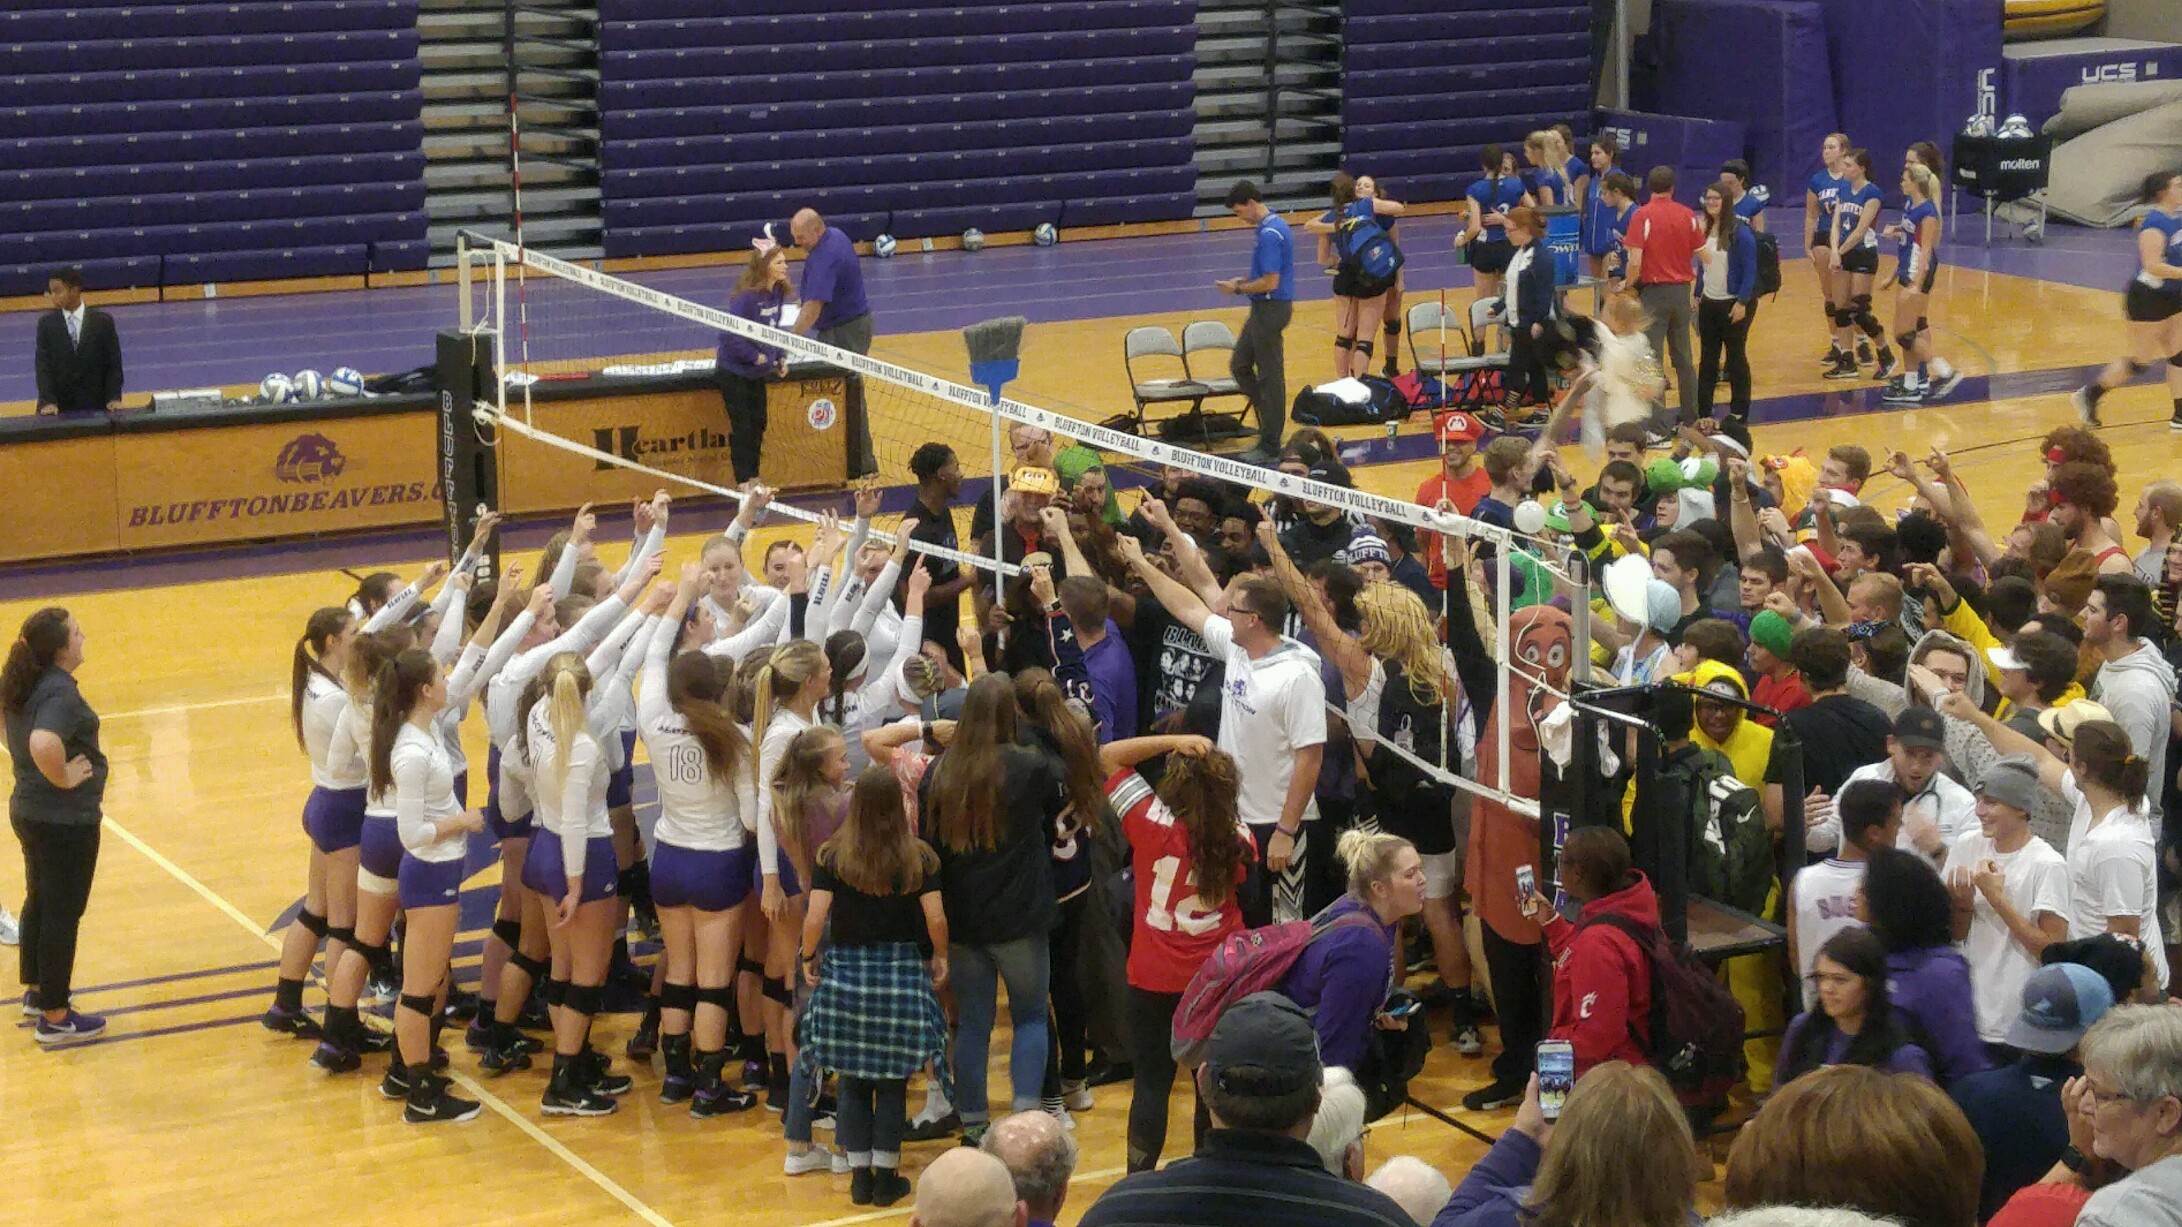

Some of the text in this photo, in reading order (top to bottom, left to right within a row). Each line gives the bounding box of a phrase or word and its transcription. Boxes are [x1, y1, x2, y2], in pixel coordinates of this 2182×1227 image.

[2081, 61, 2138, 84] UCS
[2000, 158, 2041, 171] molten
[851, 355, 924, 388] BLUFFTON VOLLEYBALL
[949, 385, 982, 405] BLUFFTON
[1053, 416, 1140, 453] BLUFFTON VOLLEYBALL
[1171, 449, 1267, 484] BLUFFTON VOLLEYBALL
[1302, 481, 1407, 518] BLUFFTON VOLLEYBALL
[669, 744, 703, 785] 18
